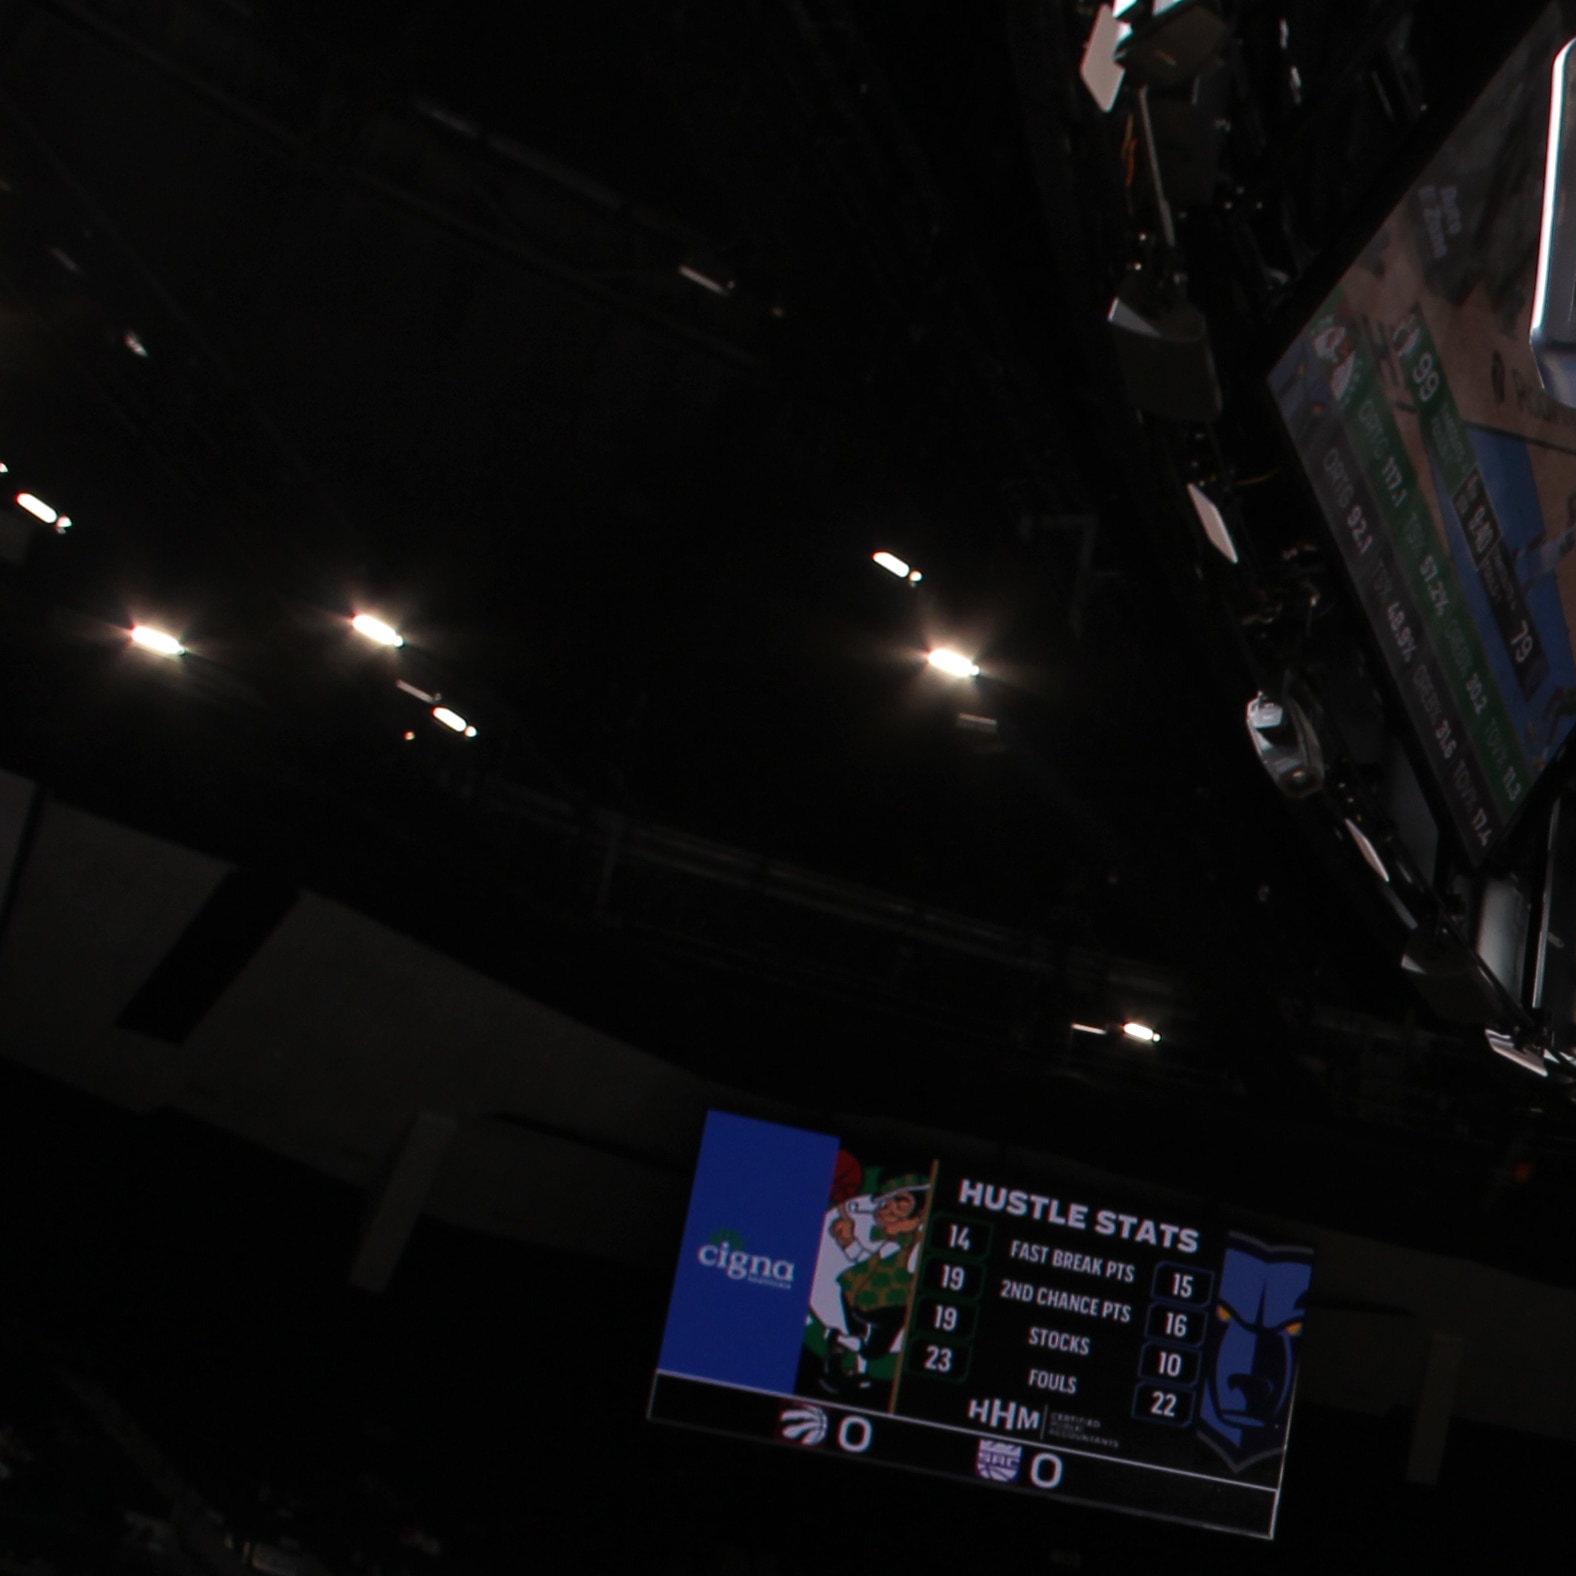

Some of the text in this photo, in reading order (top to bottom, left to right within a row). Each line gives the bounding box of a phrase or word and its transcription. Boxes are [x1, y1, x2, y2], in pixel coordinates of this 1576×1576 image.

[1412, 352, 1440, 403] 99
[1346, 503, 1373, 554] 92.1
[1511, 619, 1534, 664] 79
[957, 1178, 1200, 1254] HUSTLE STATS
[697, 1241, 795, 1284] cigna
[947, 1223, 1194, 1298] 14 FAST BREAK PTS 15
[940, 1264, 1188, 1338] 19 2ND CHANCE PTS 16
[933, 1304, 1183, 1377] 19 STOCKS 10
[922, 1345, 1177, 1417] 23 FOULS 22
[966, 1398, 1041, 1431] HHM
